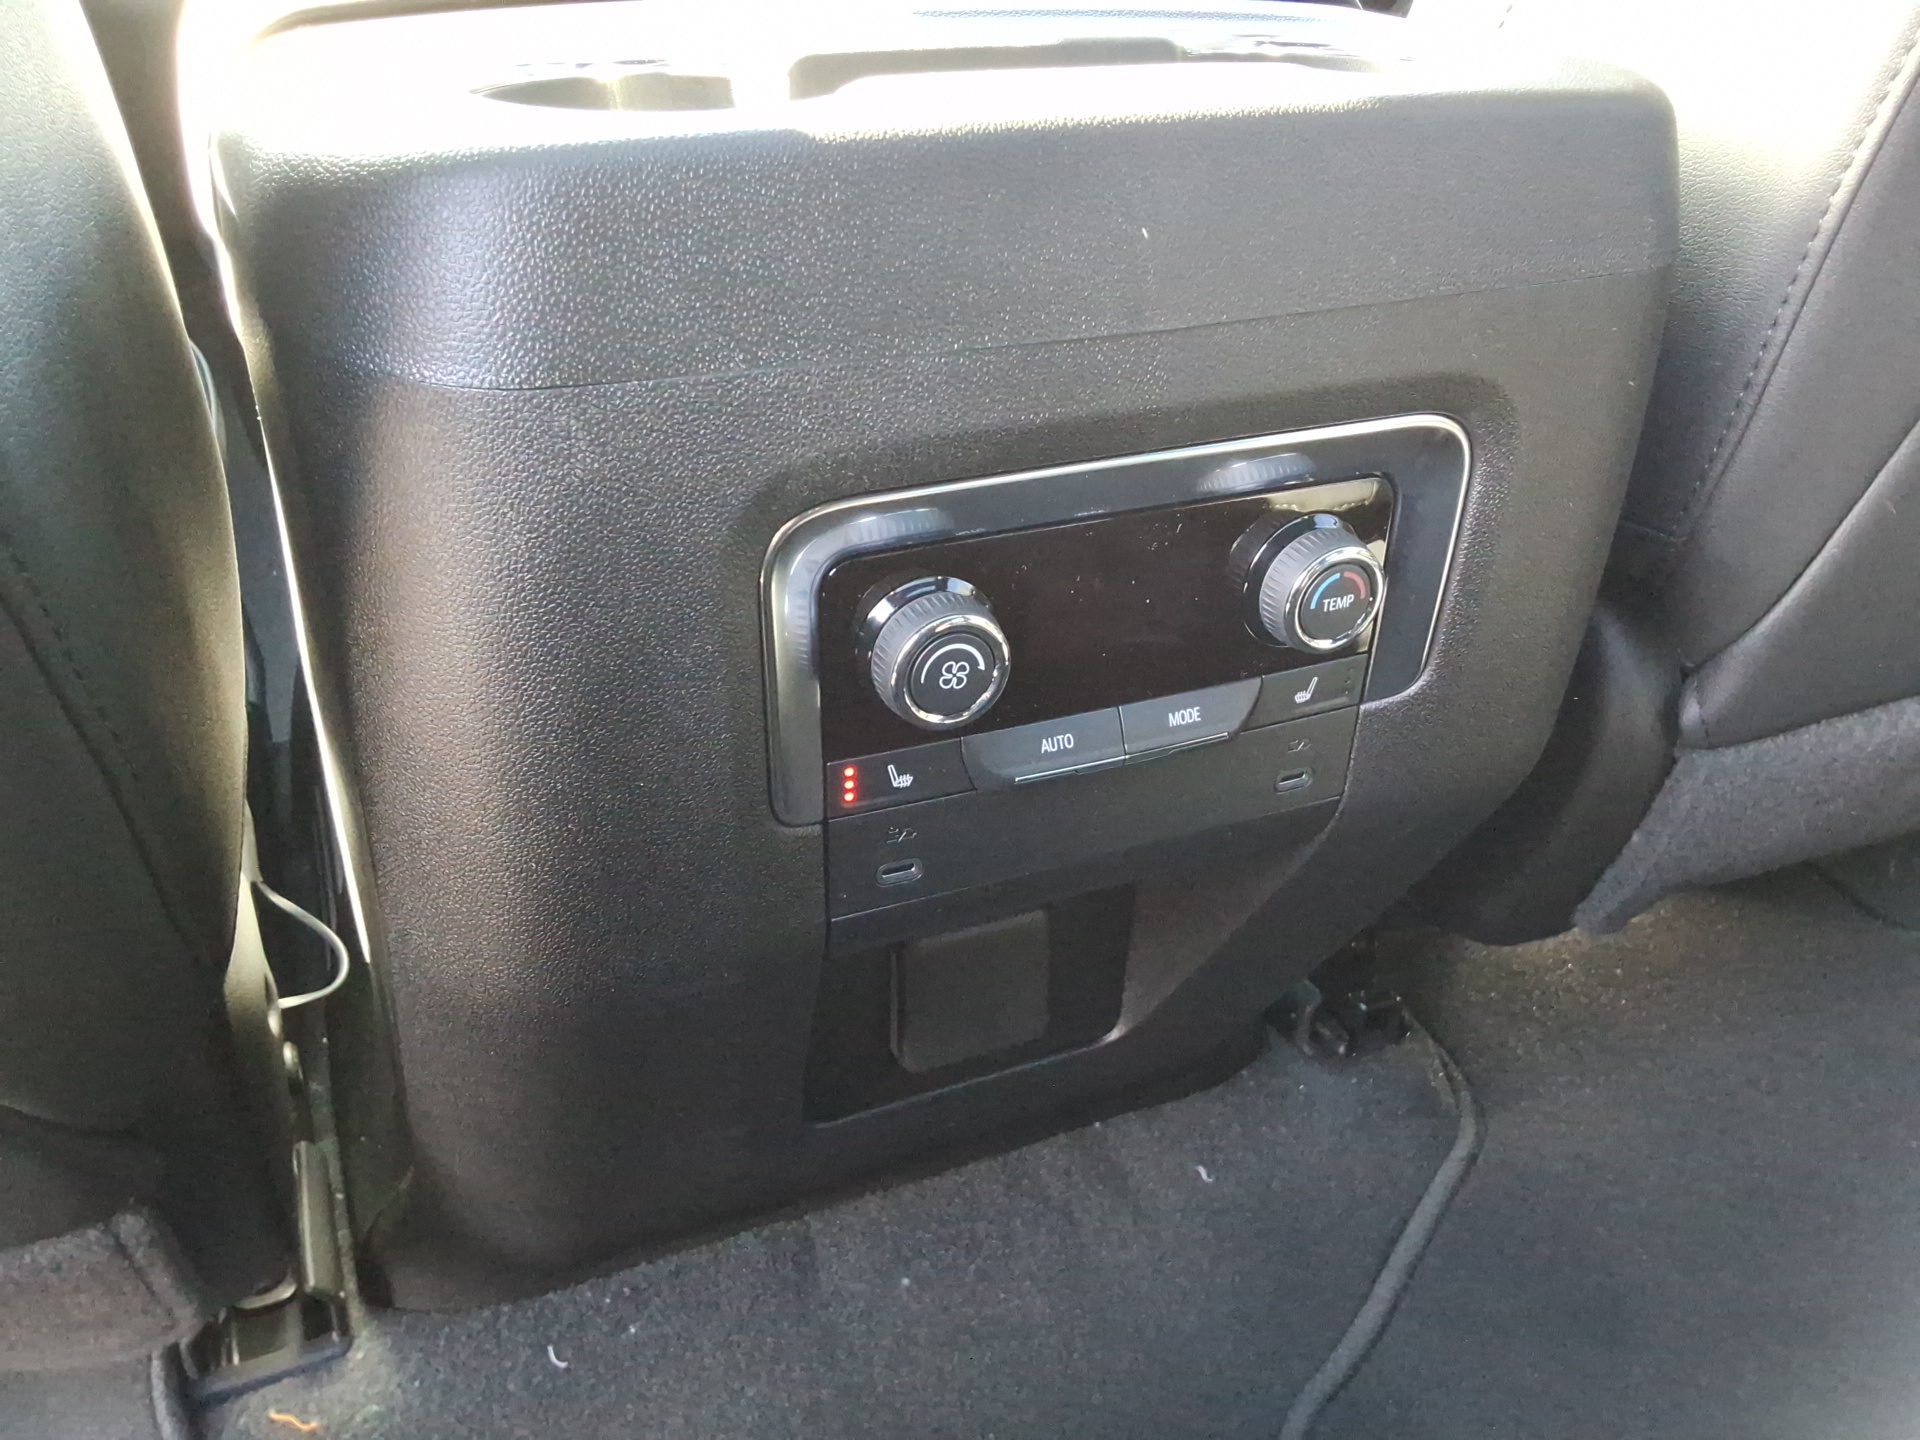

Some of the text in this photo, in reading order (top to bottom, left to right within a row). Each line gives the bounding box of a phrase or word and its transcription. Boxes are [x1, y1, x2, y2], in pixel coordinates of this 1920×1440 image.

[1322, 593, 1355, 612] TEMP
[1168, 706, 1202, 727] MODE
[1041, 733, 1074, 753] AUTO
